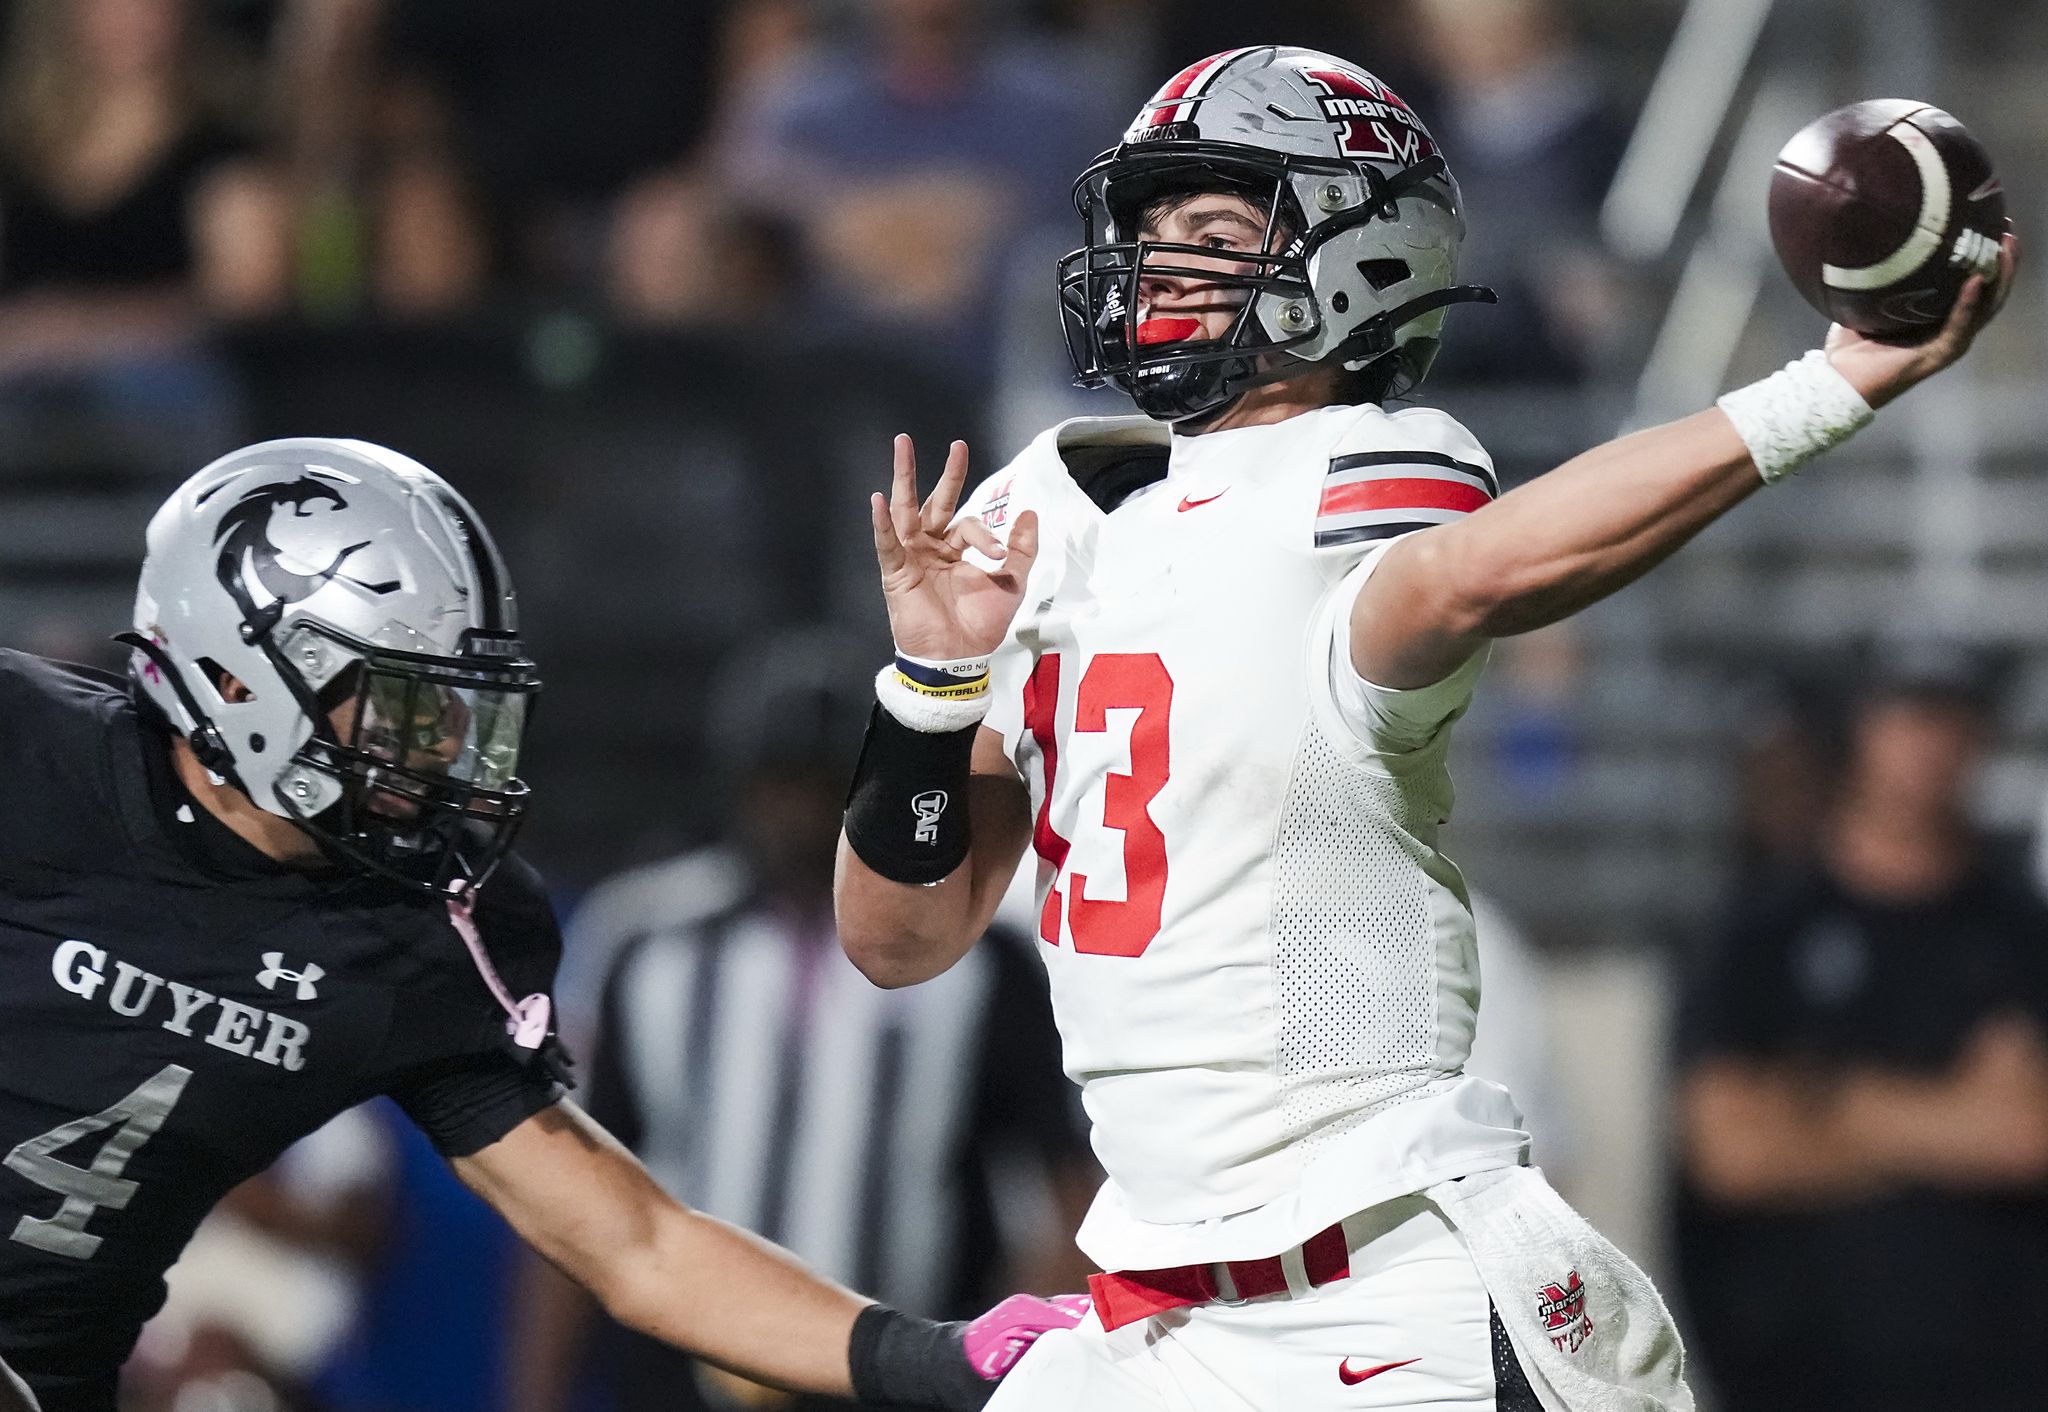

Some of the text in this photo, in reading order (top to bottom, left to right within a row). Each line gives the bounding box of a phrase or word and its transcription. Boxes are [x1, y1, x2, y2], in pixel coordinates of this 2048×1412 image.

[1323, 98, 1423, 132] marcu
[922, 685, 980, 698] FOOTBALL
[914, 794, 942, 842] TAG
[1023, 653, 1174, 958] 13
[52, 939, 312, 1072] GUYER
[2, 1063, 194, 1260] 4
